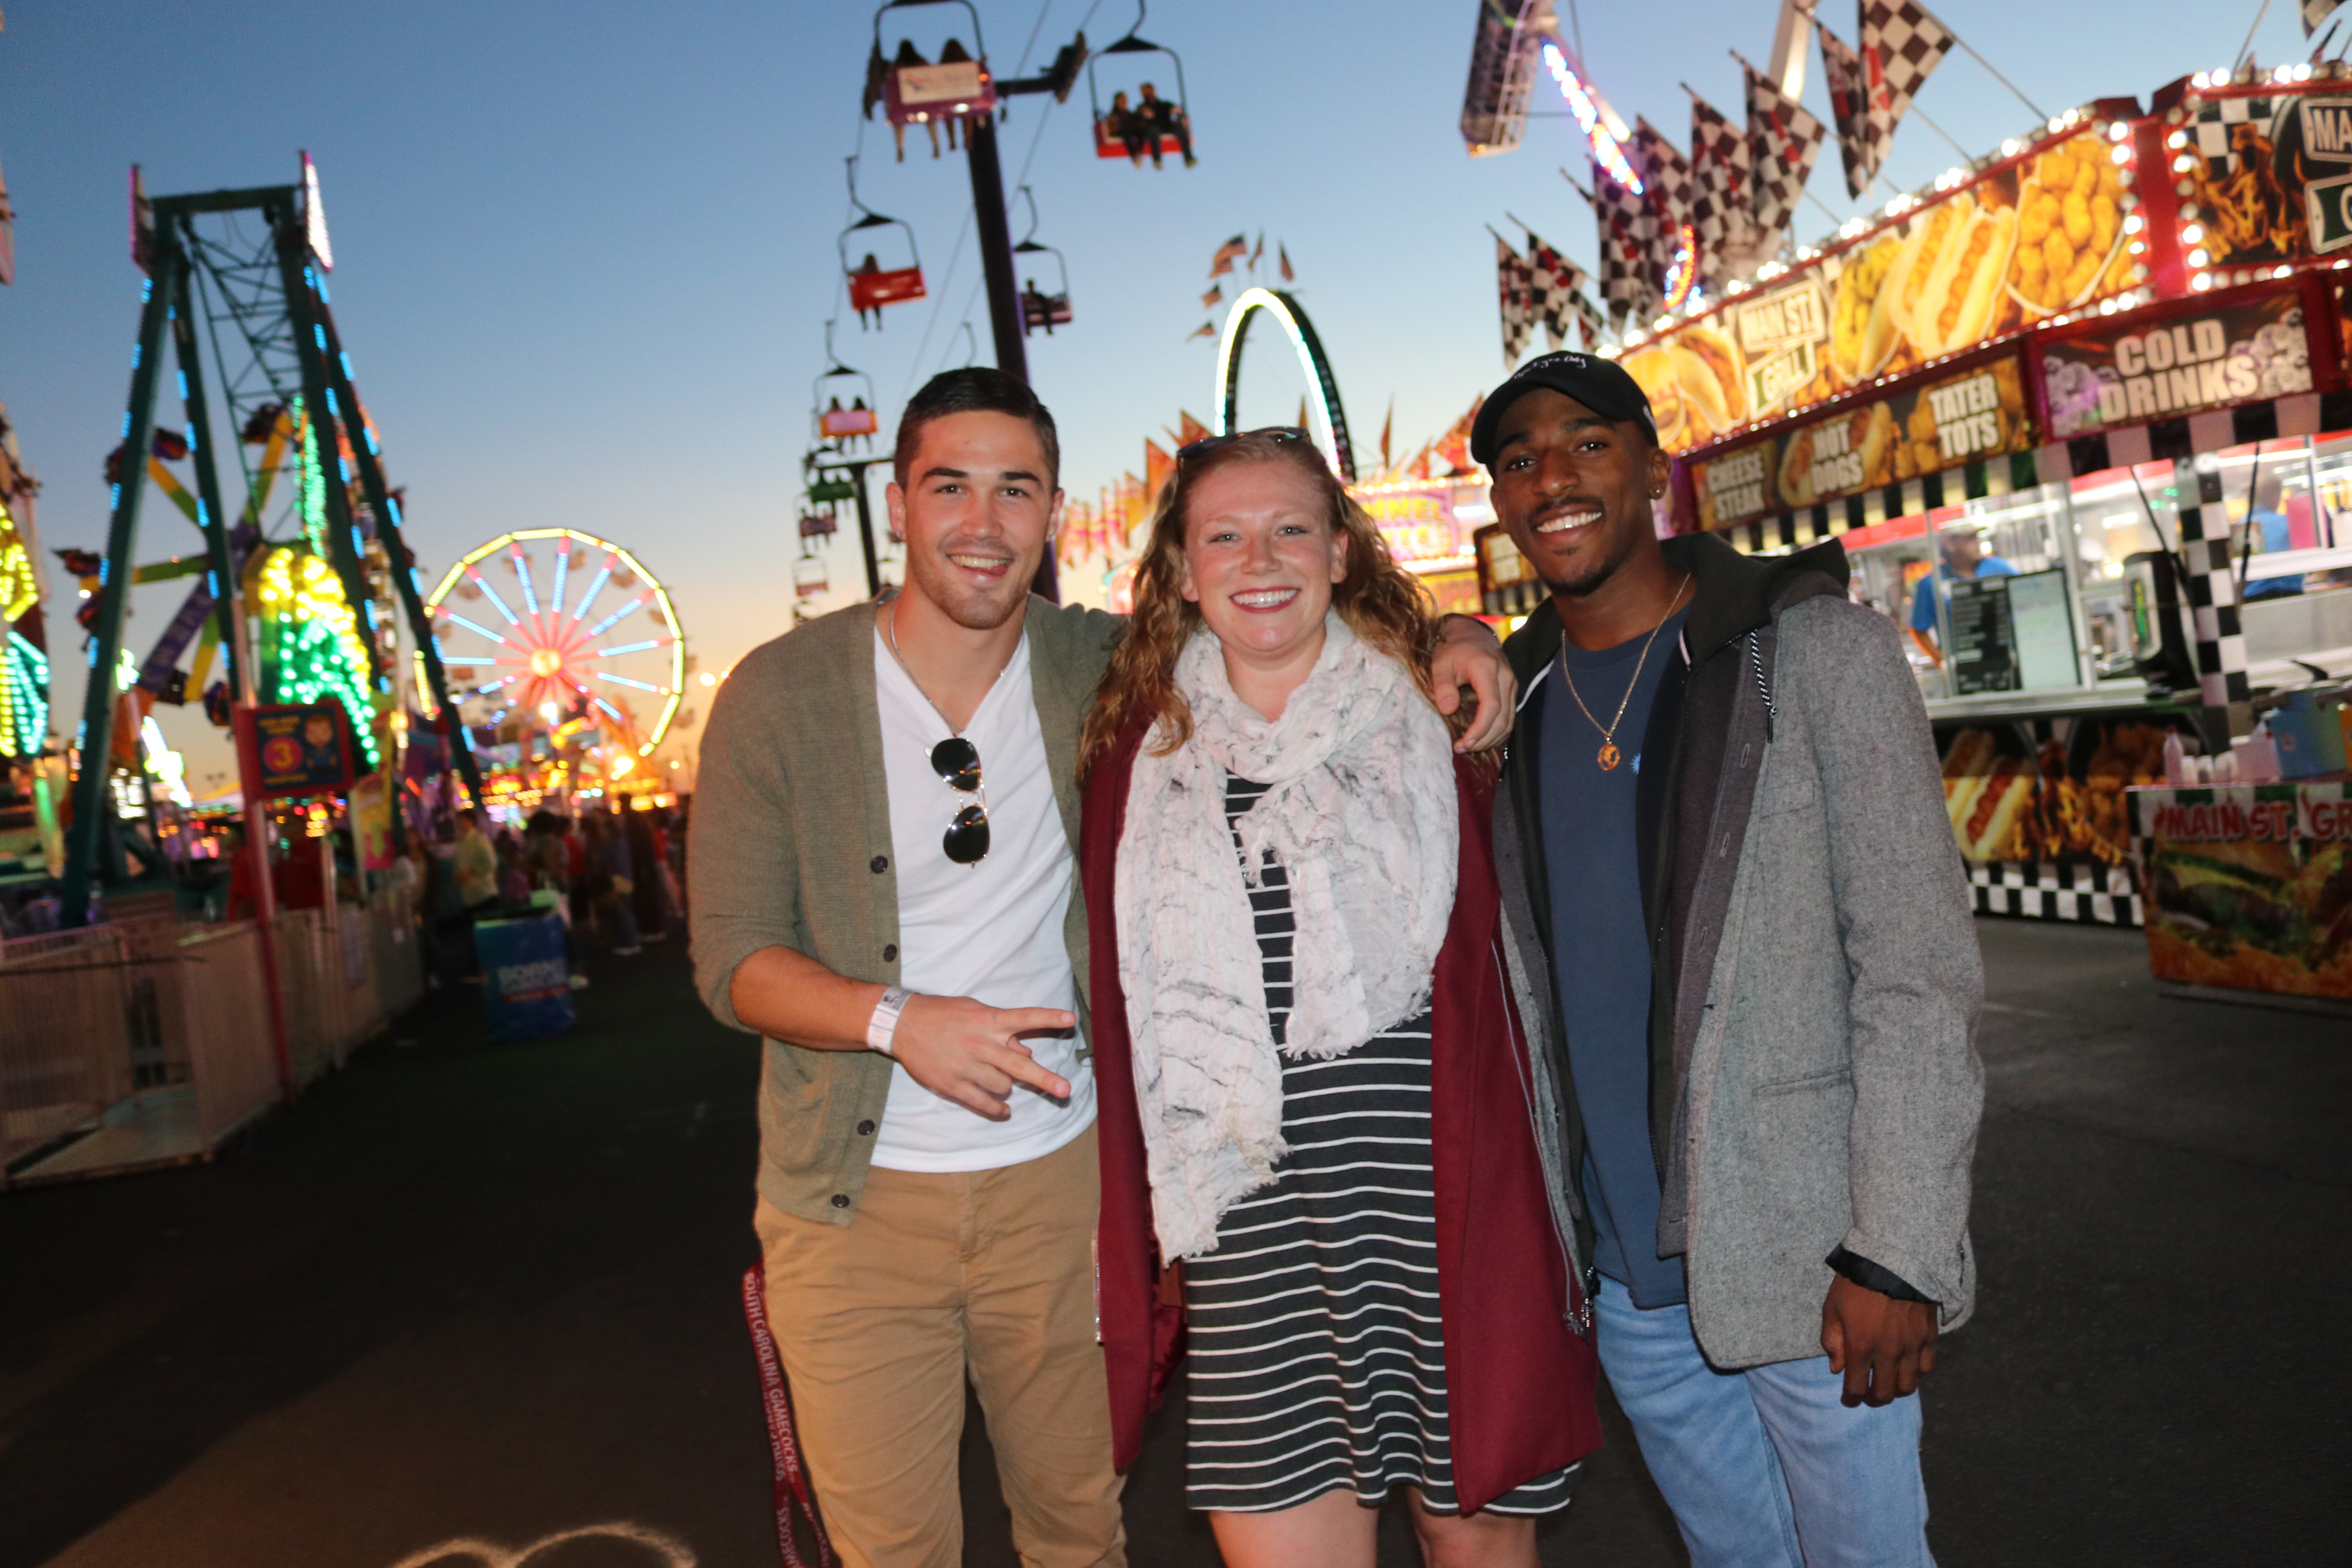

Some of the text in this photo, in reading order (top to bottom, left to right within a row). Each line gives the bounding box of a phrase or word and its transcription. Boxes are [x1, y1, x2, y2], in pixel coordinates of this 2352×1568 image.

[2313, 109, 2352, 152] MA
[2115, 319, 2226, 377] COLD
[1928, 373, 1998, 424] TATER
[2098, 354, 2258, 423] DRINKS
[1937, 412, 1998, 459] TOTS
[274, 742, 293, 768] 3
[2165, 802, 2244, 838] MAIN
[2311, 801, 2352, 837] GR
[745, 1272, 763, 1318] SOUTH
[752, 1319, 780, 1387] CAROLINA
[769, 1388, 798, 1472] GAMECOCKS
